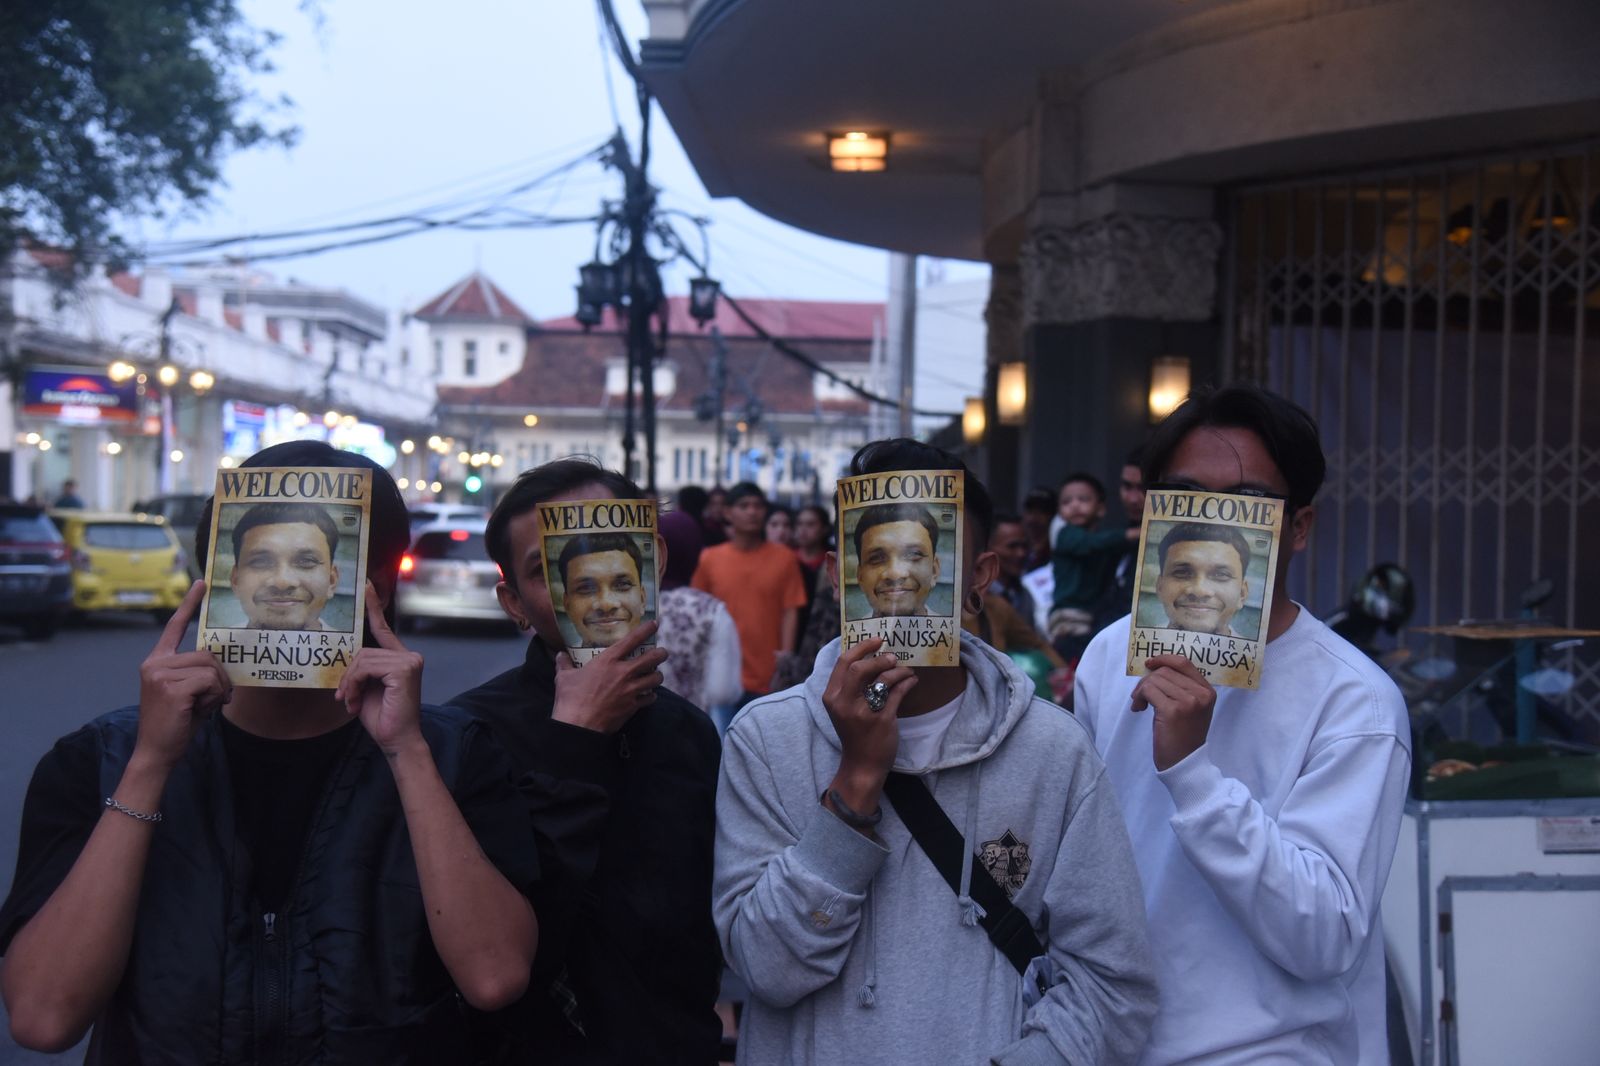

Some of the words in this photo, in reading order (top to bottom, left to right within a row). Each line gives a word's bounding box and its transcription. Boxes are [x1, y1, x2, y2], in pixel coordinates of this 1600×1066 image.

[221, 471, 364, 500] WELCOME
[840, 475, 957, 505] WELCOME
[540, 504, 653, 531] WELCOME
[1150, 494, 1276, 526] WELCOME
[210, 632, 236, 642] AL
[258, 632, 347, 646] HAMRA
[849, 622, 866, 632] AL
[880, 619, 948, 629] HAMRA
[1138, 630, 1158, 640] AL
[1176, 632, 1251, 652] HAMRA
[1135, 641, 1249, 671] HEHANUSSA
